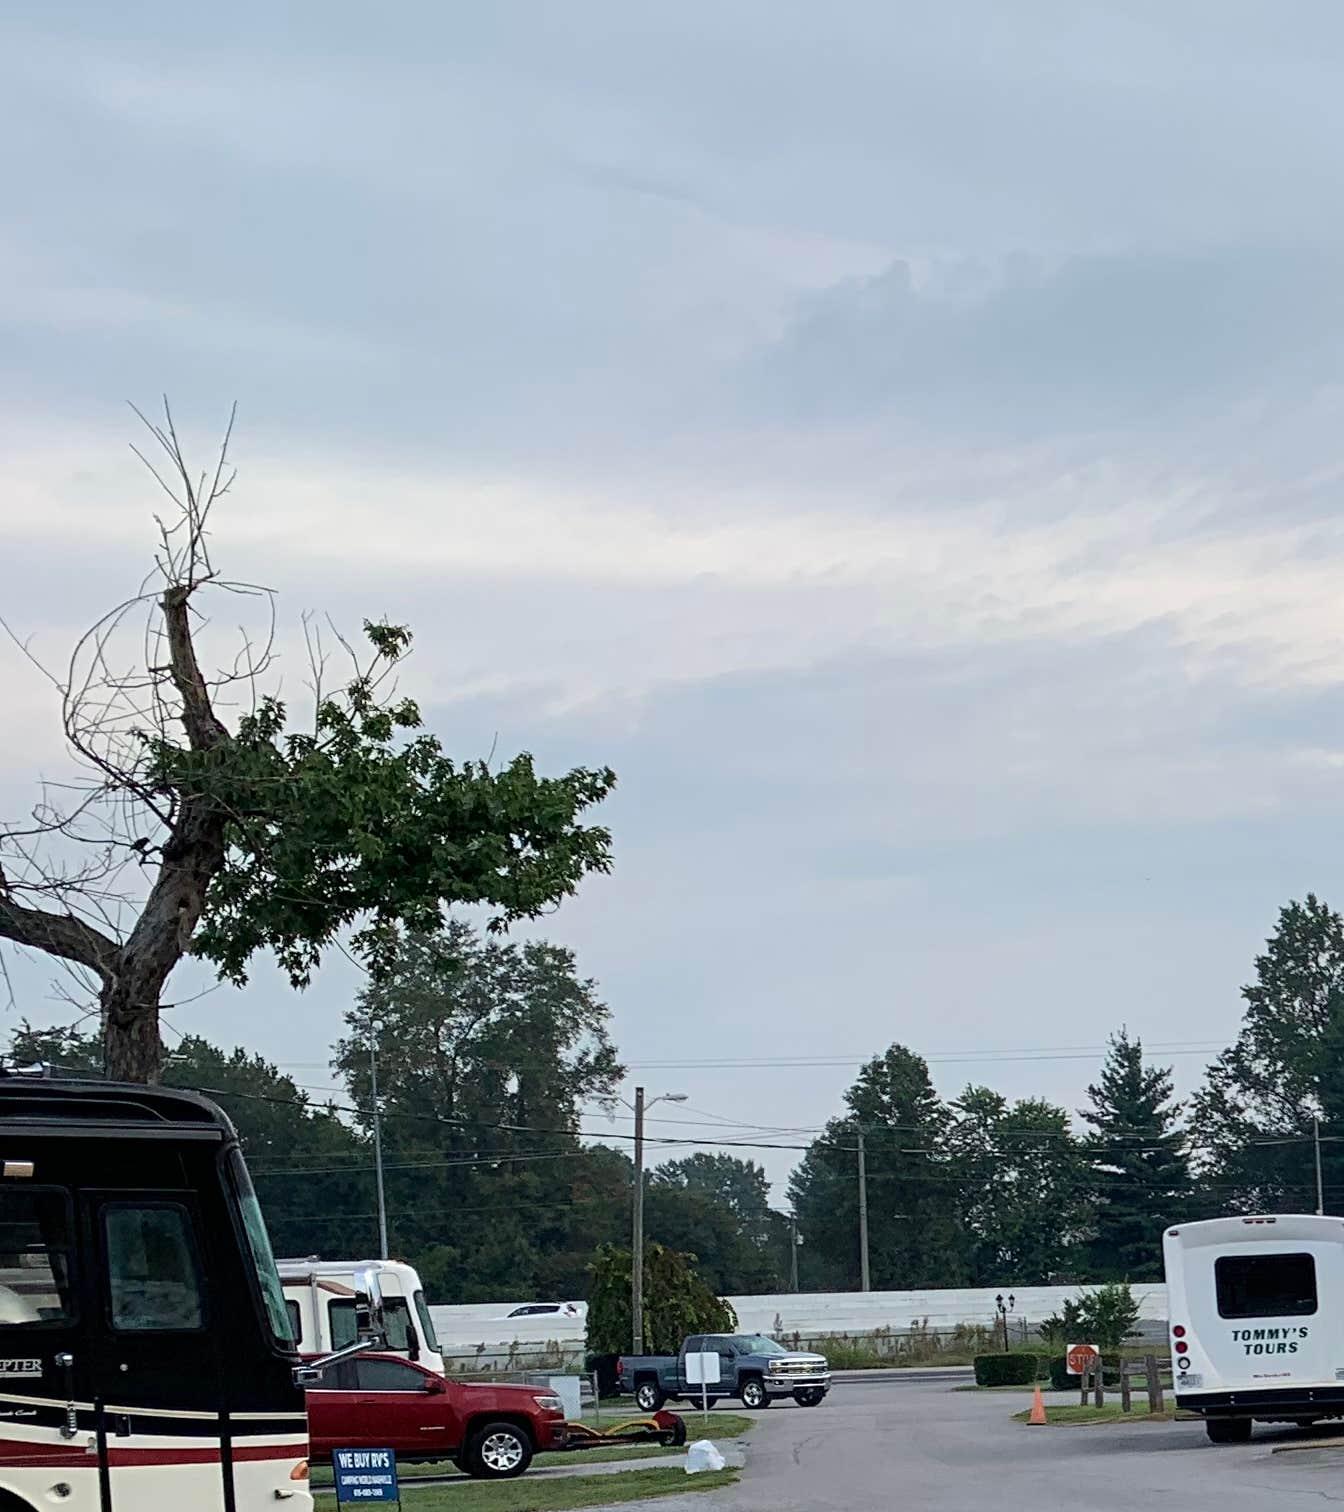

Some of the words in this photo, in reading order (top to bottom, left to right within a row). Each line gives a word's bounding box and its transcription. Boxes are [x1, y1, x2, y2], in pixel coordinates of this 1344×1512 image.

[1232, 1327, 1308, 1341] TOMMY'S
[1244, 1342, 1298, 1355] TOURS
[338, 1453, 353, 1469] WE
[353, 1452, 370, 1468] BUY
[371, 1452, 390, 1468] RV'S
